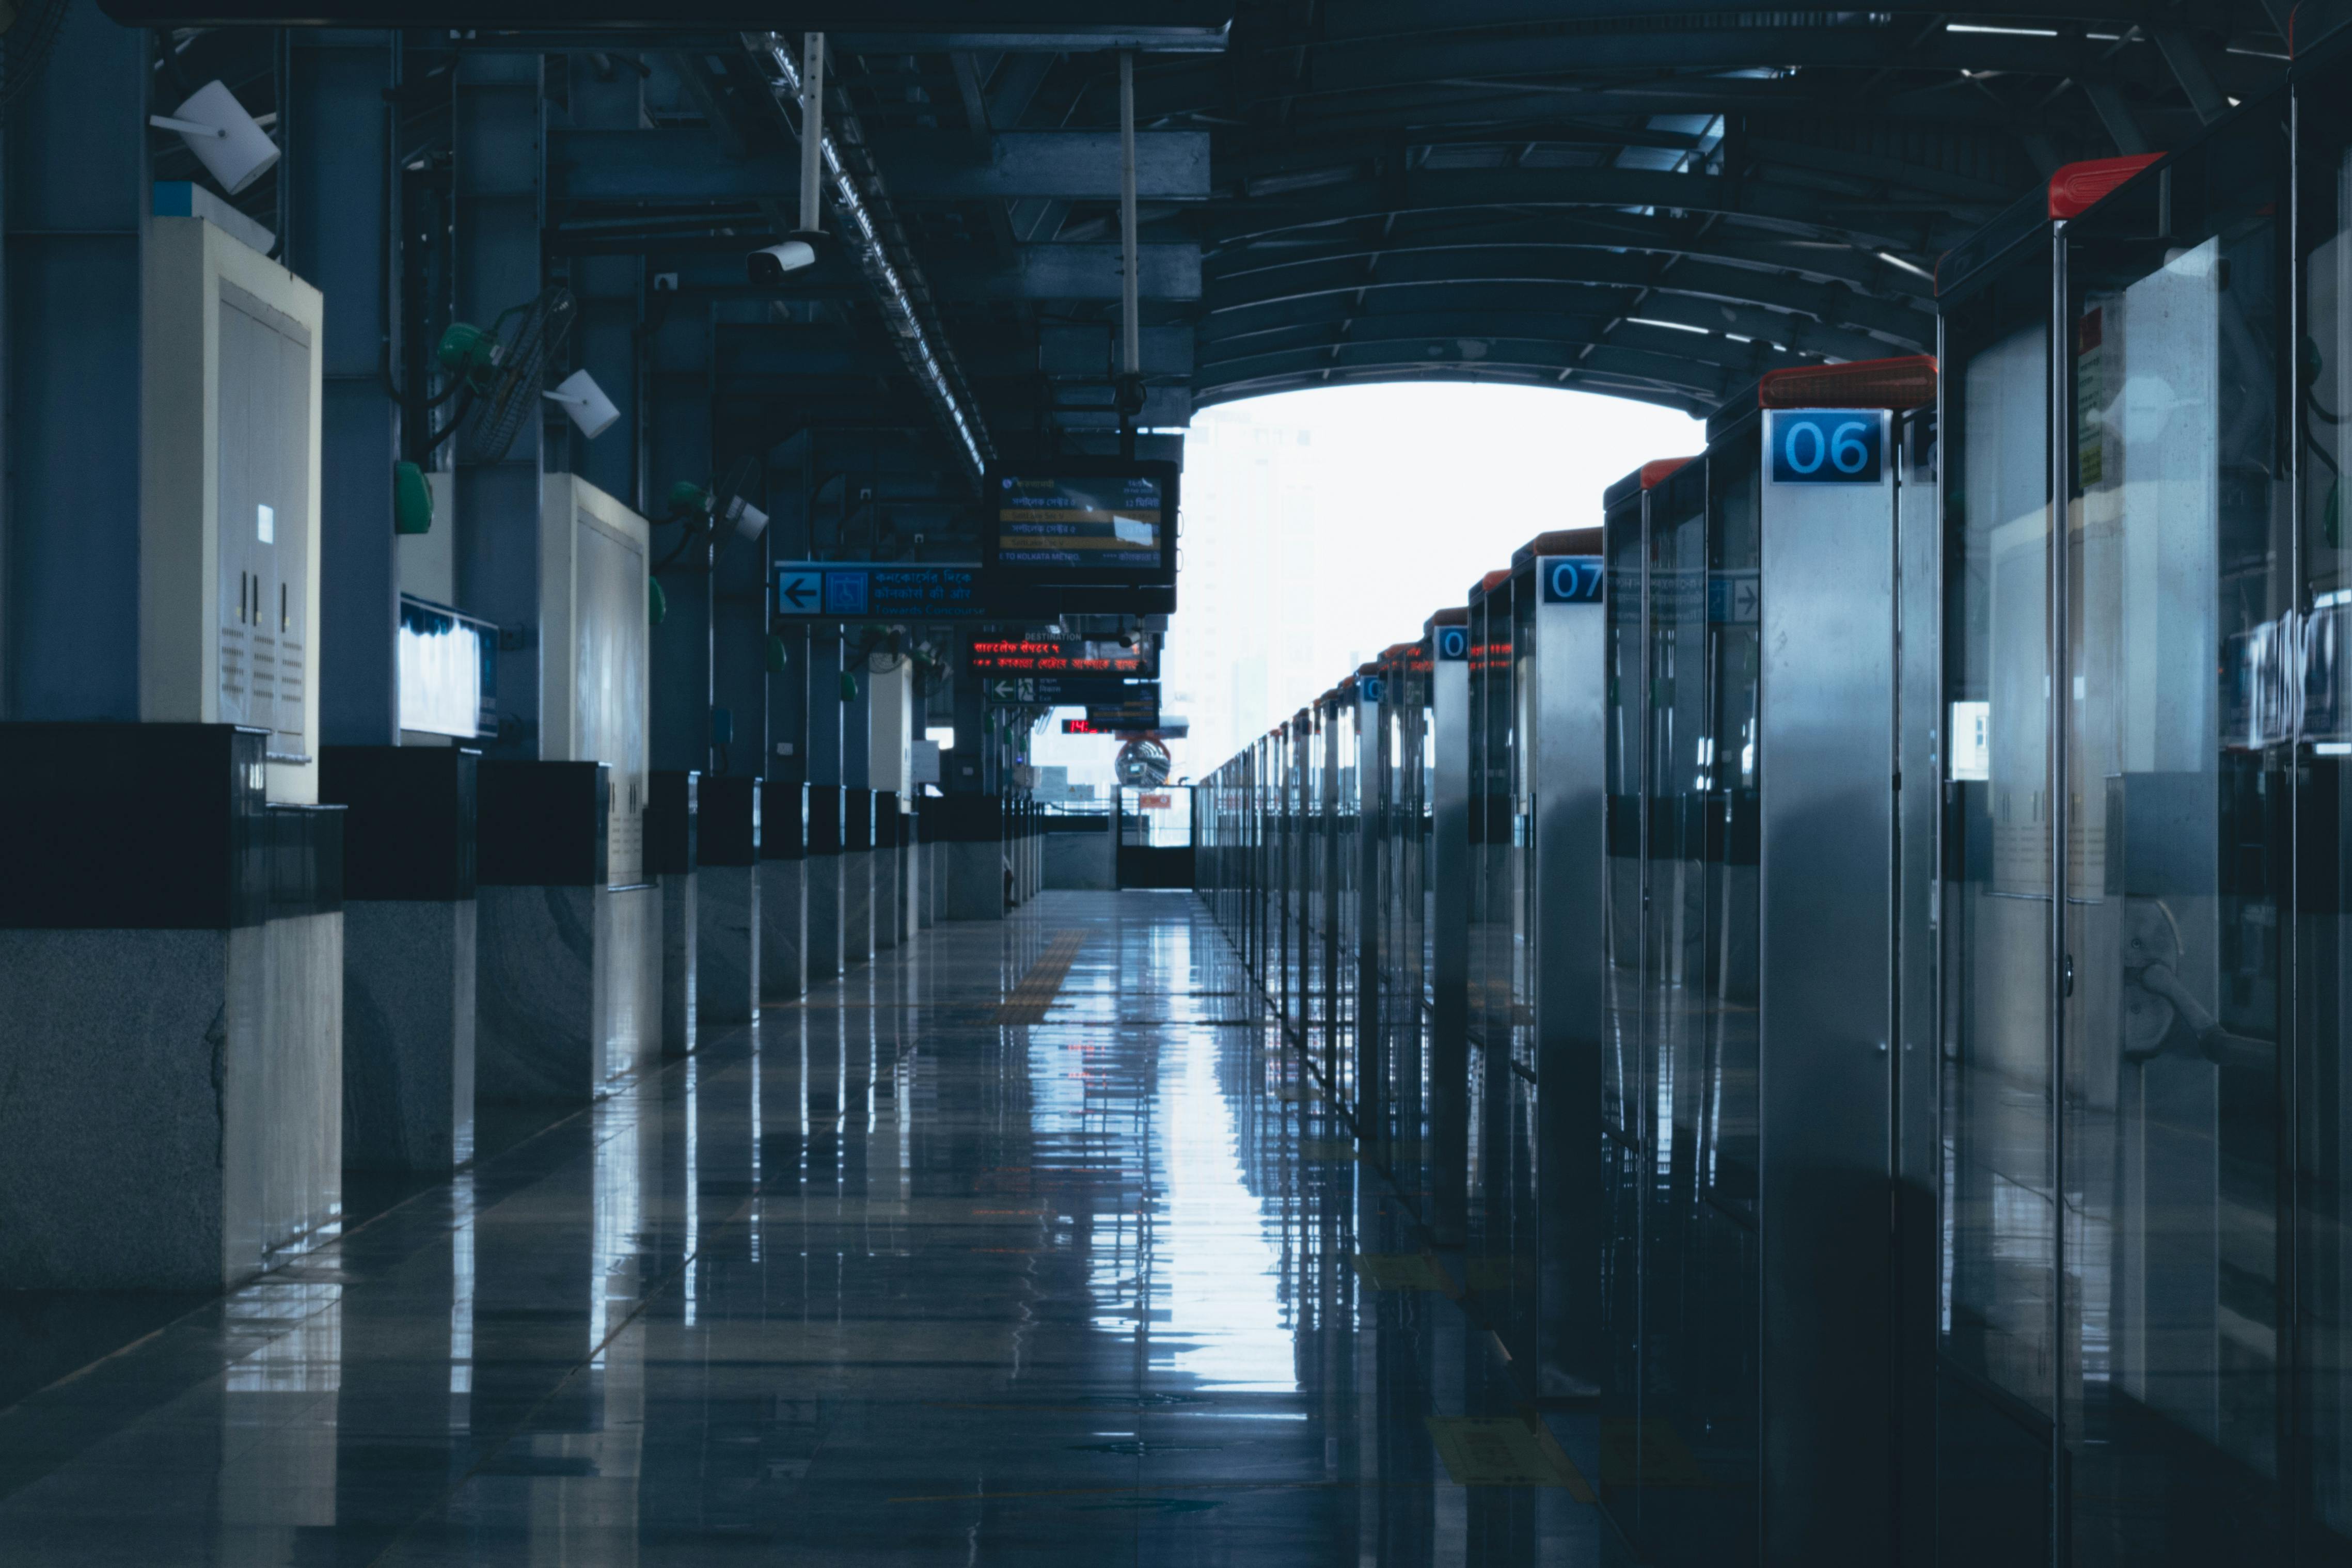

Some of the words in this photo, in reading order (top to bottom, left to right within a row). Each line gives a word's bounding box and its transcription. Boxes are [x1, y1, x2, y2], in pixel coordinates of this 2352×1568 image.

[1785, 421, 1869, 474] 06
[1552, 563, 1603, 598] 07
[875, 603, 922, 615] Towards
[925, 603, 985, 615] Concourse
[1025, 632, 1081, 641] DESTINATION
[1444, 631, 1464, 657] 0
